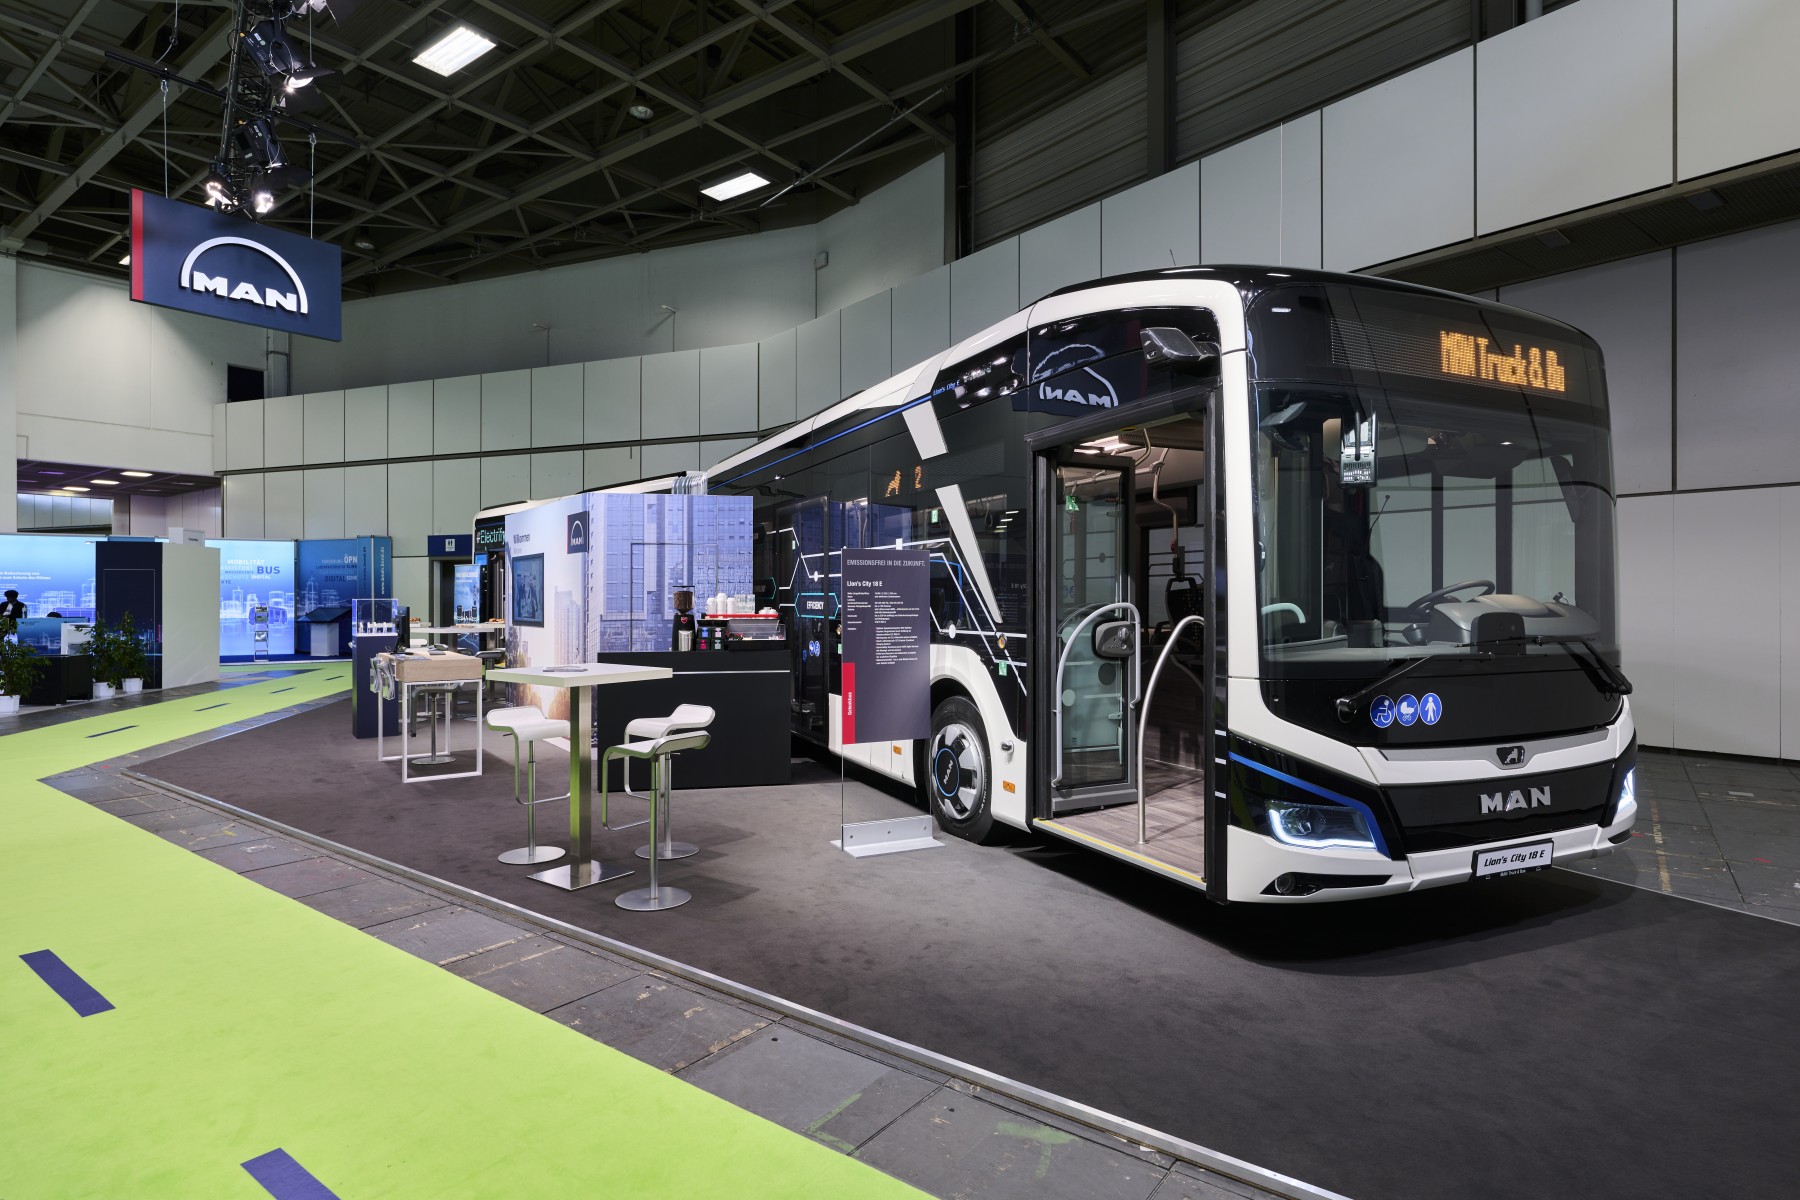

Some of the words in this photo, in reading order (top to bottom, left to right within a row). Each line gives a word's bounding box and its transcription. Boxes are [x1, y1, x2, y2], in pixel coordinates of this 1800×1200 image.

[193, 270, 298, 313] MAN
[1476, 336, 1528, 386] Truck
[1529, 347, 1546, 389] &
[257, 565, 281, 575] BUS
[1479, 786, 1551, 814] MAN
[1484, 855, 1508, 867] Lion's
[1510, 853, 1527, 863] City
[1528, 851, 1539, 860] 18
[1539, 849, 1546, 858] E
